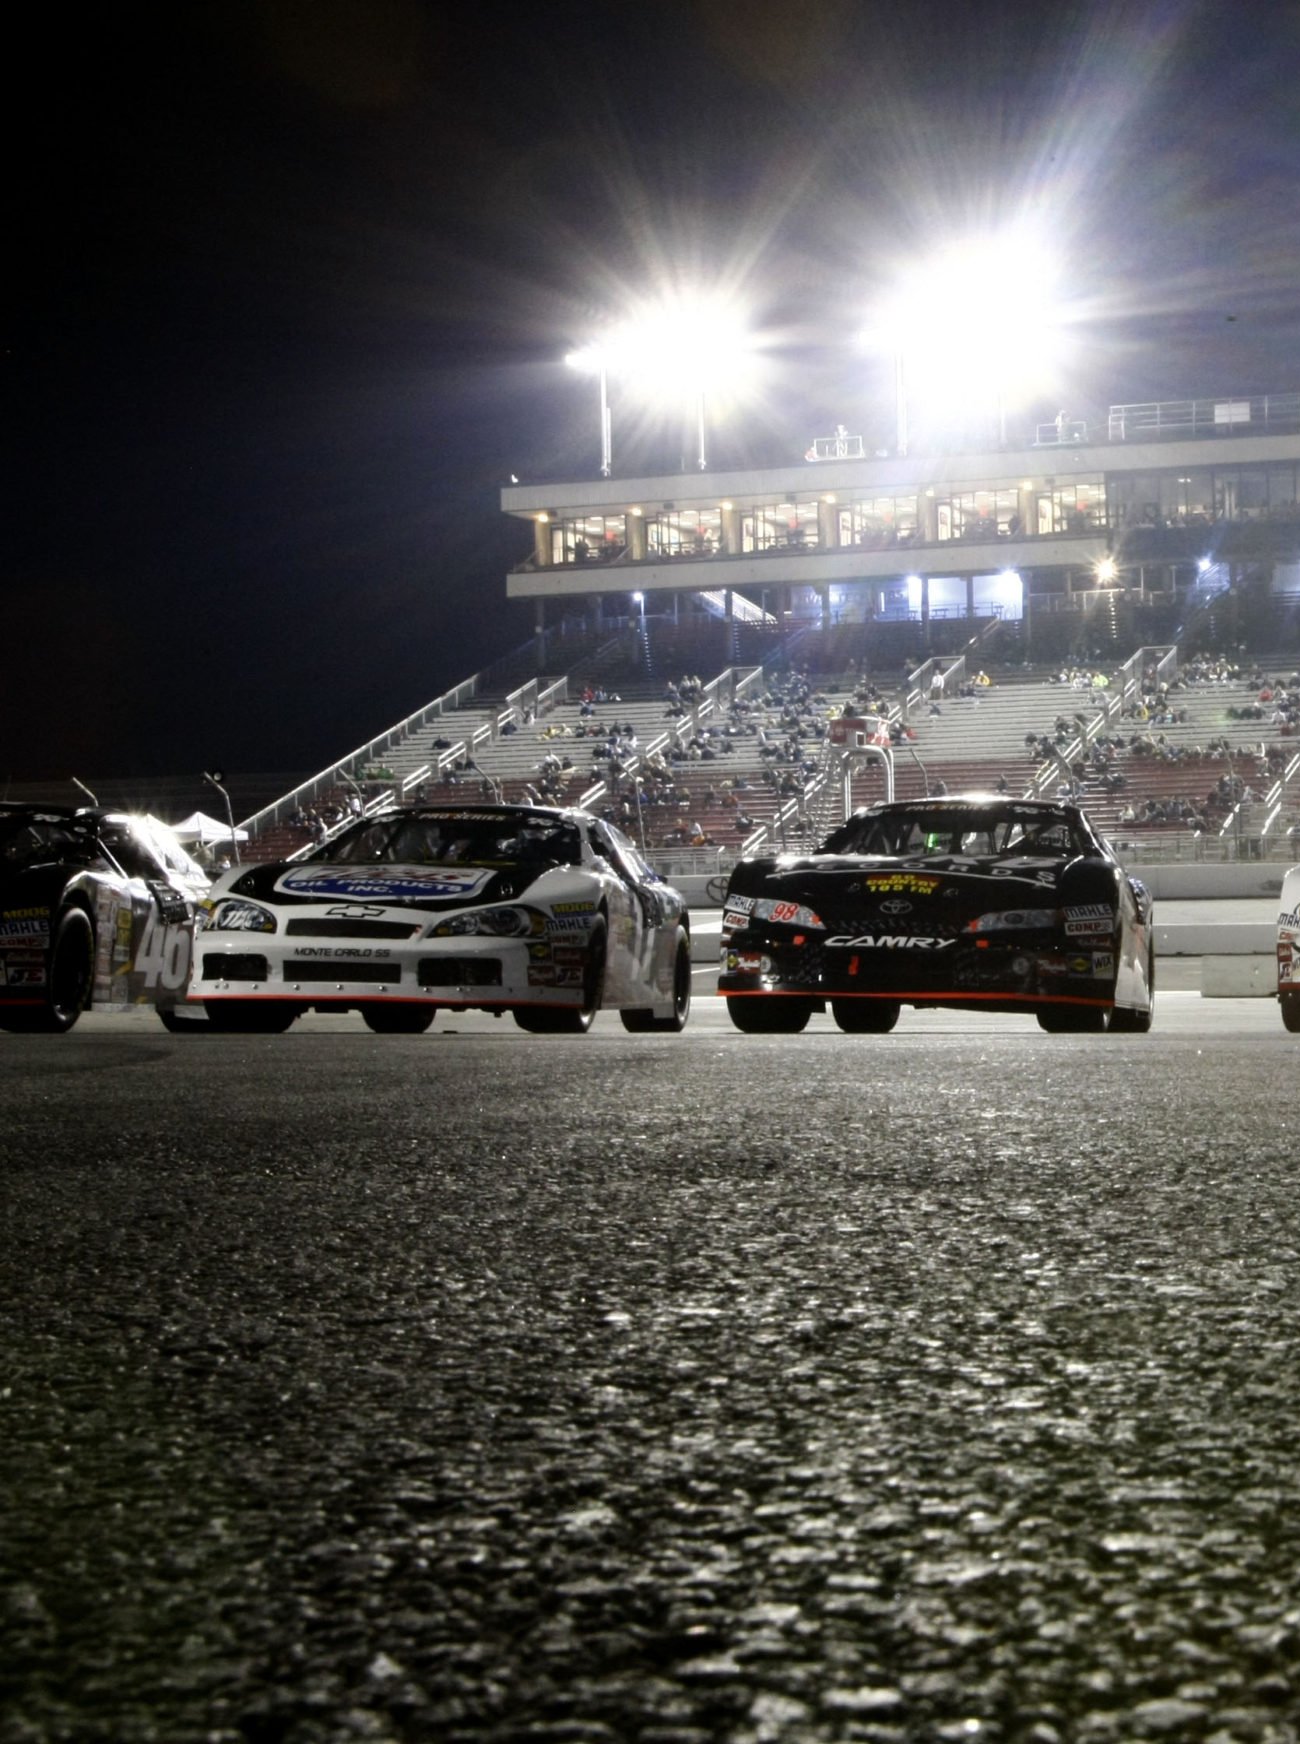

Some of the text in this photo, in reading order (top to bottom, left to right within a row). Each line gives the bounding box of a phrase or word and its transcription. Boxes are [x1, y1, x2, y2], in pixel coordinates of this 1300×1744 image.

[289, 879, 463, 892] OIL PRODUCTS
[347, 885, 393, 894] INC.
[910, 886, 932, 894] FM
[2, 907, 49, 920] MOOG
[768, 902, 800, 923] 98
[1065, 904, 1112, 918] MAHLE
[546, 917, 591, 931] MAHLE
[1067, 922, 1101, 932] COMP
[823, 935, 958, 949] CAMRY
[294, 947, 391, 958] MONTE CARLO SS
